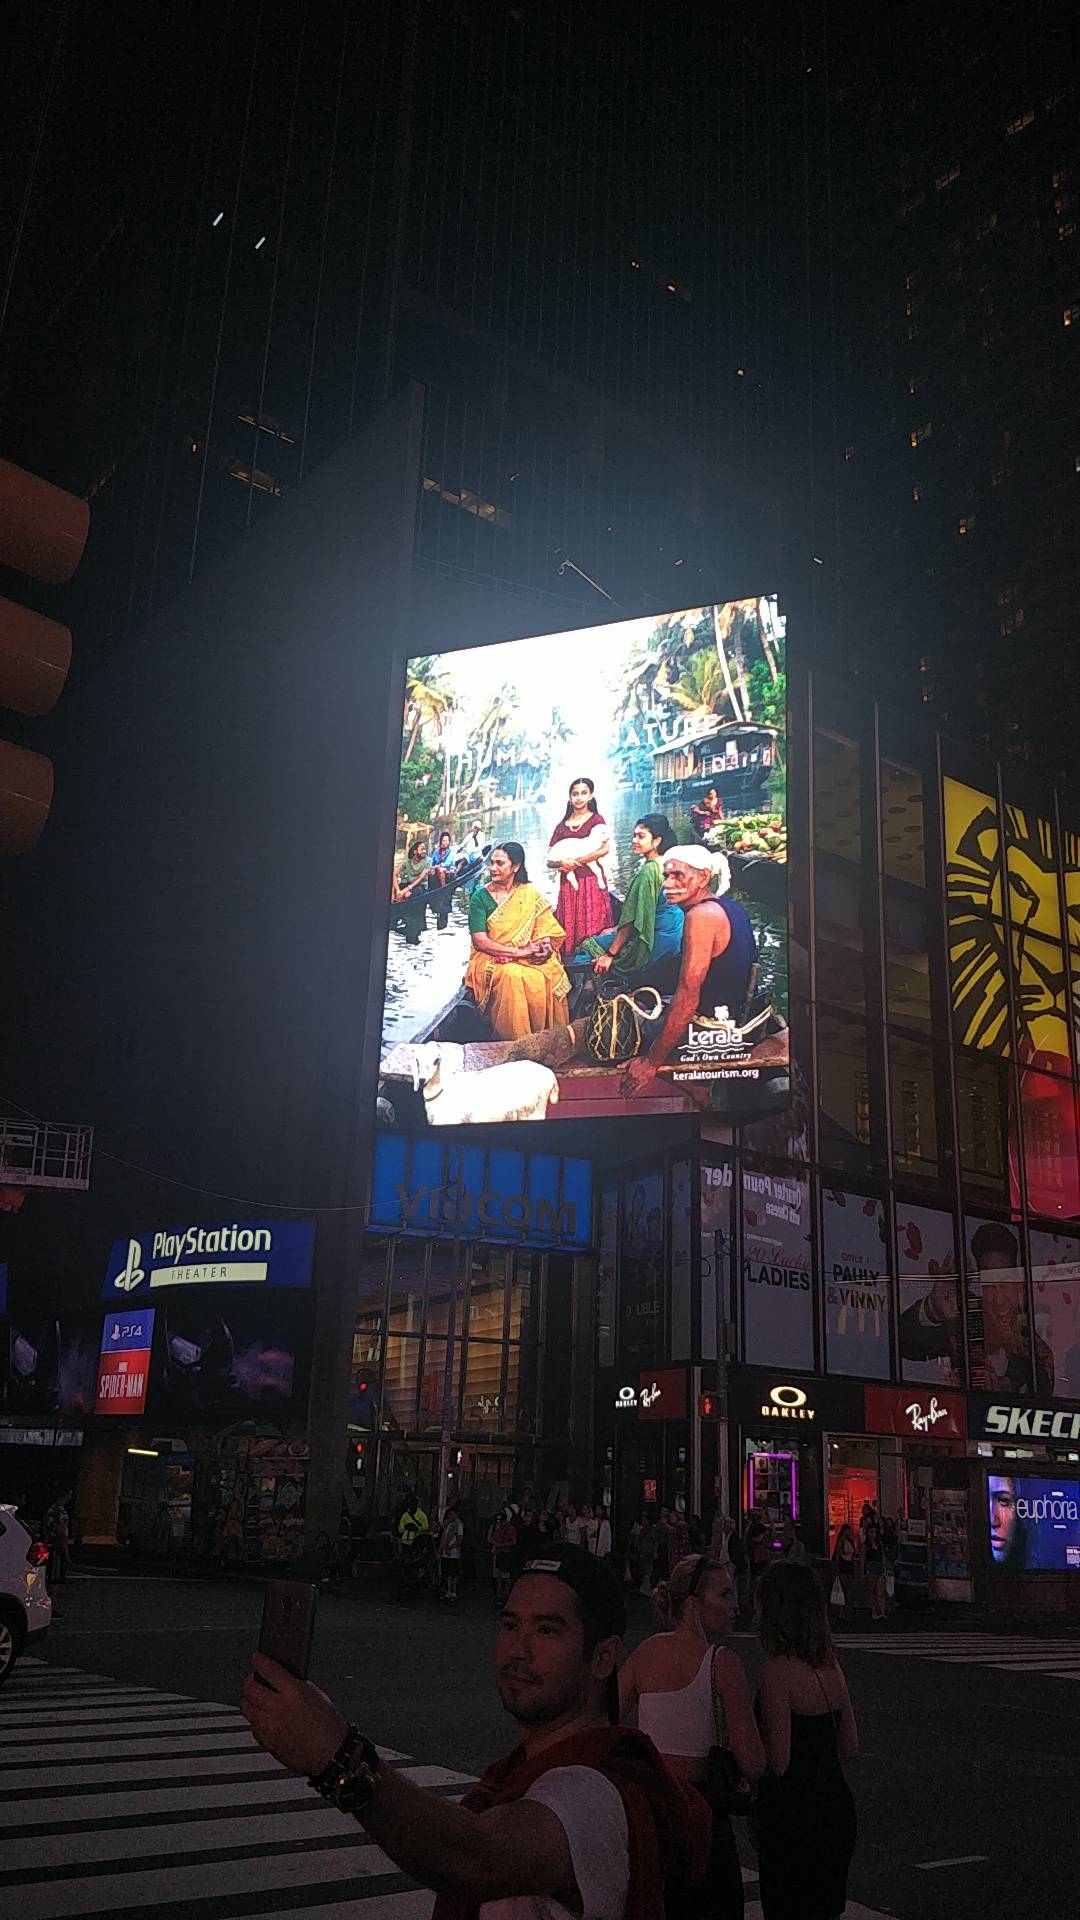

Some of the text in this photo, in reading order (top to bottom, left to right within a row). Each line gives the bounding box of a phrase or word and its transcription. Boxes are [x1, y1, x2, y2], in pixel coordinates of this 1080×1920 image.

[688, 1023, 743, 1045] kerala
[673, 1069, 759, 1080] keralatourism.org
[152, 1223, 272, 1264] PlayStation
[171, 1267, 227, 1280] THEATER
[746, 1261, 810, 1291] LADIES
[839, 1288, 886, 1312] VINNY
[121, 1324, 143, 1338] PS4
[100, 1373, 145, 1399] SPIDER-MAN
[761, 1405, 816, 1420] OAKLEY
[905, 1396, 949, 1432] Ray-Ban
[1016, 1494, 1079, 1524] euphoria
